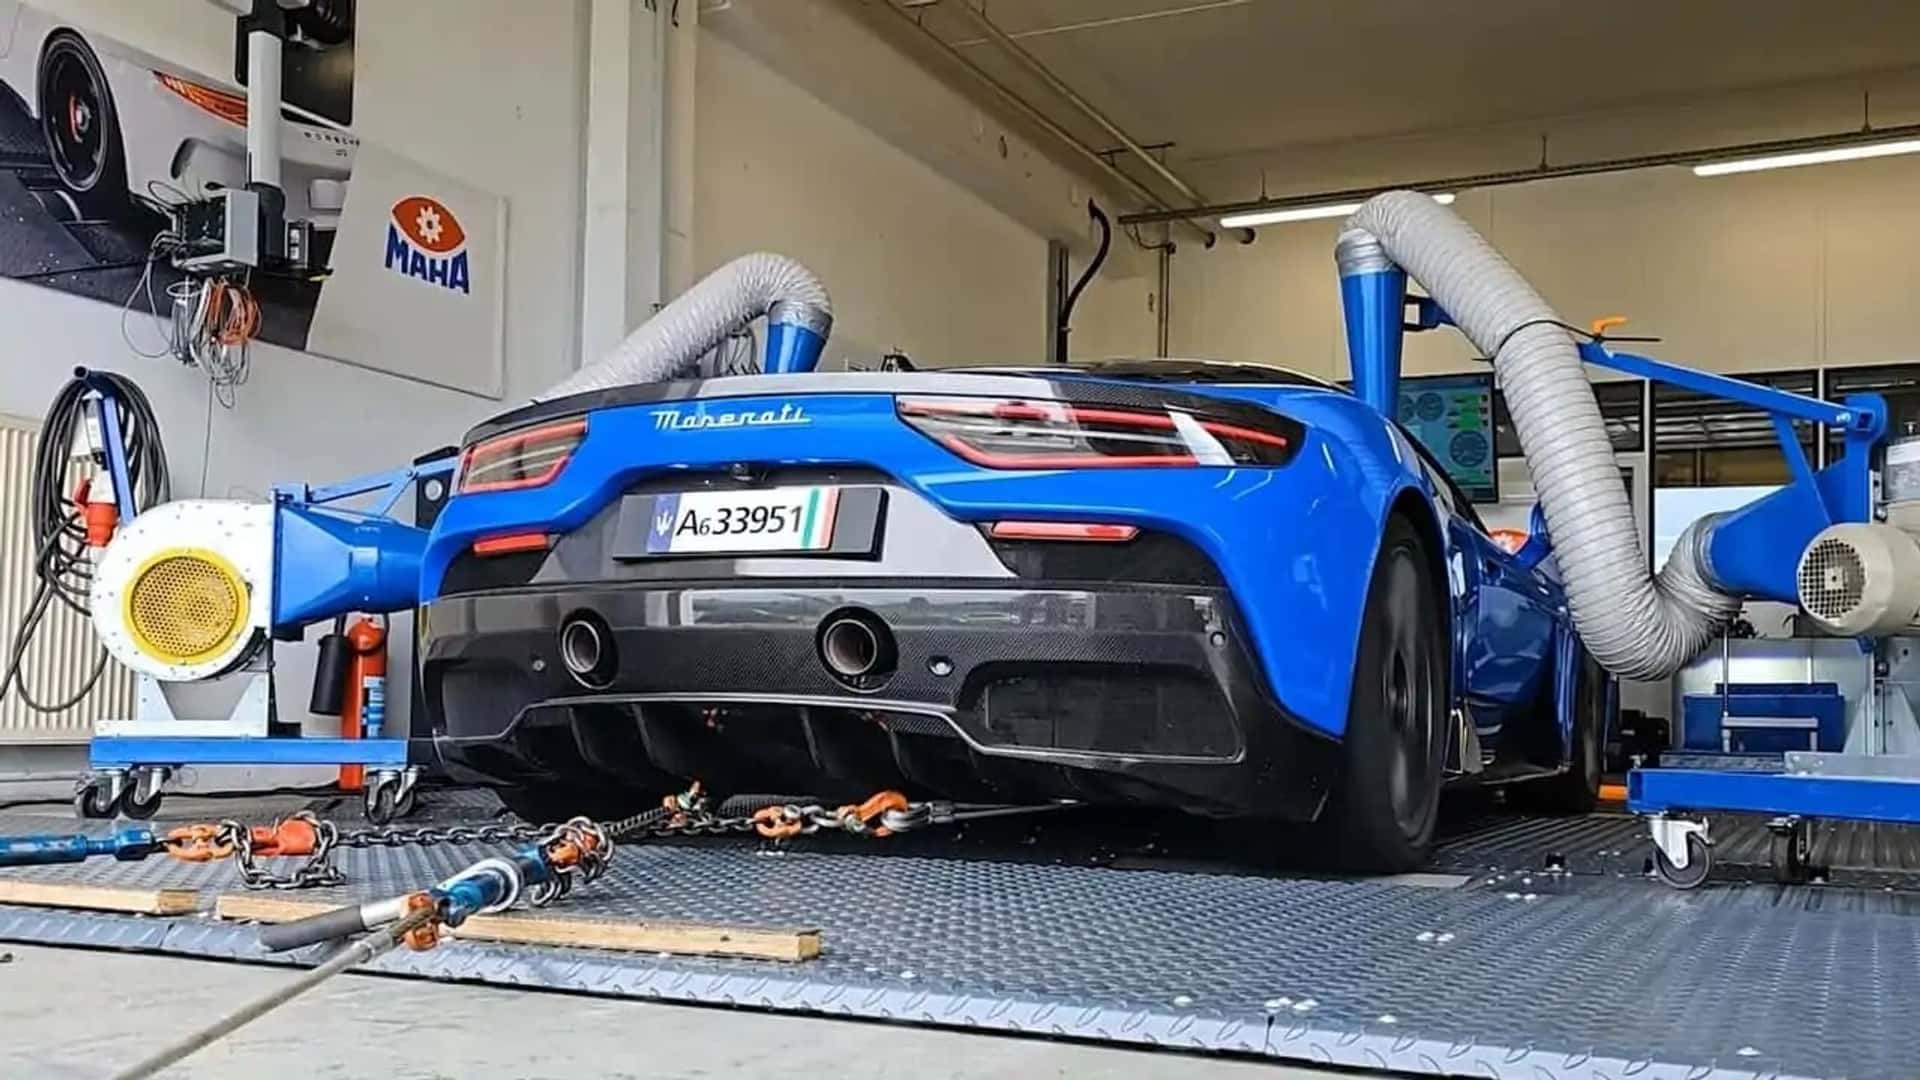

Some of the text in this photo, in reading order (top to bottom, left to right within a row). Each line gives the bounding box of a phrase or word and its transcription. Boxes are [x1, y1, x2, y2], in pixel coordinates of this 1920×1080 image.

[384, 221, 469, 295] MAHA
[650, 403, 813, 430] Maserati
[676, 505, 803, 536] A633951
